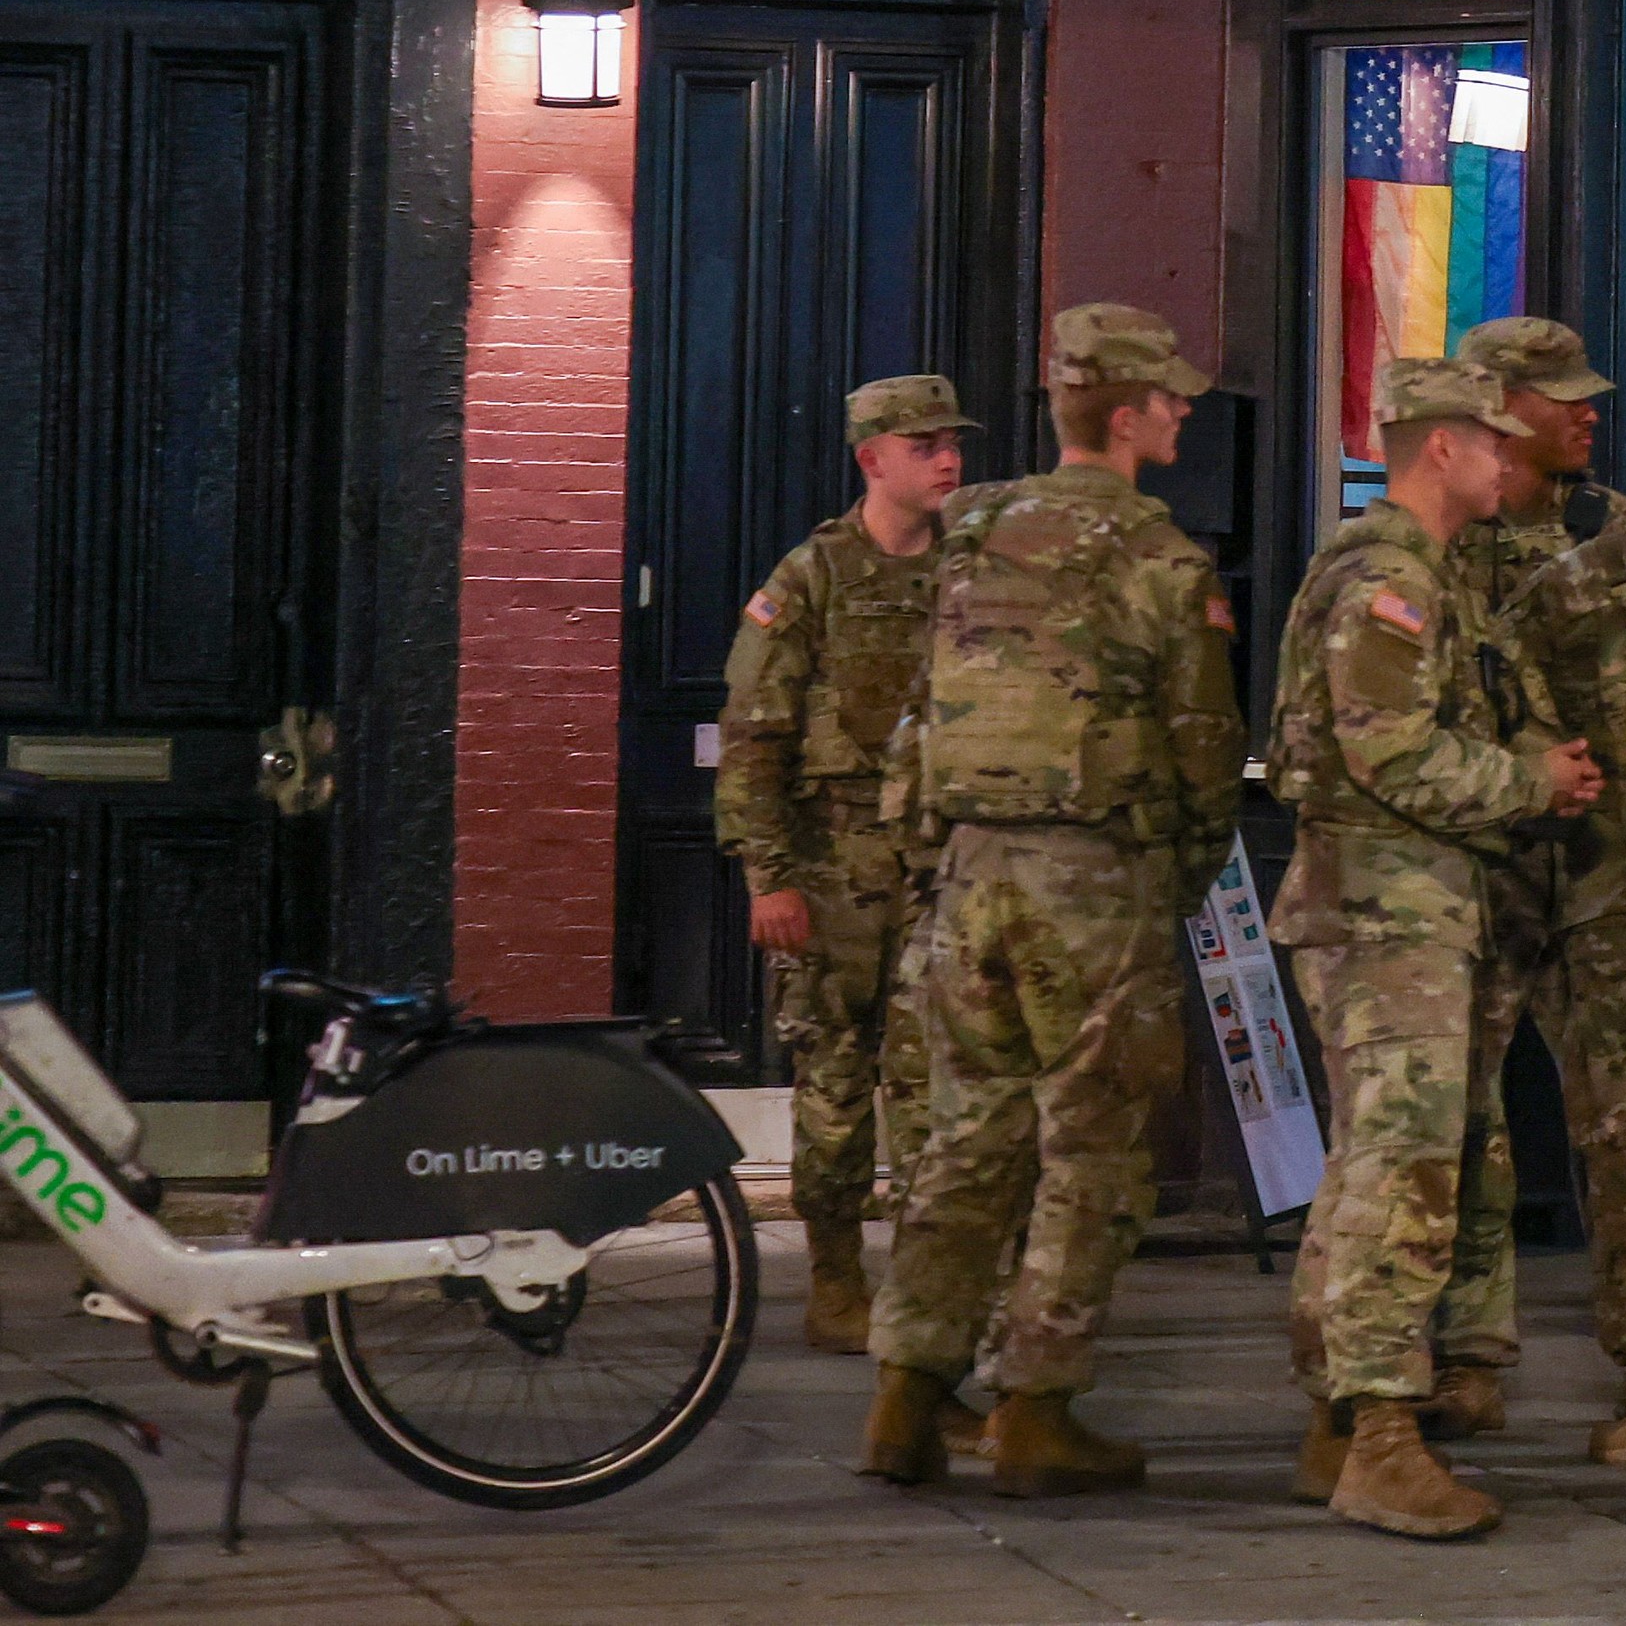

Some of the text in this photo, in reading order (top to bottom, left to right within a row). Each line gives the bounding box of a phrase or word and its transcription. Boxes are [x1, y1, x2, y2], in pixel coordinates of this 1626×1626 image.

[405, 1148, 457, 1175] On
[464, 1144, 546, 1173] Lime
[585, 1142, 665, 1170] Uber
